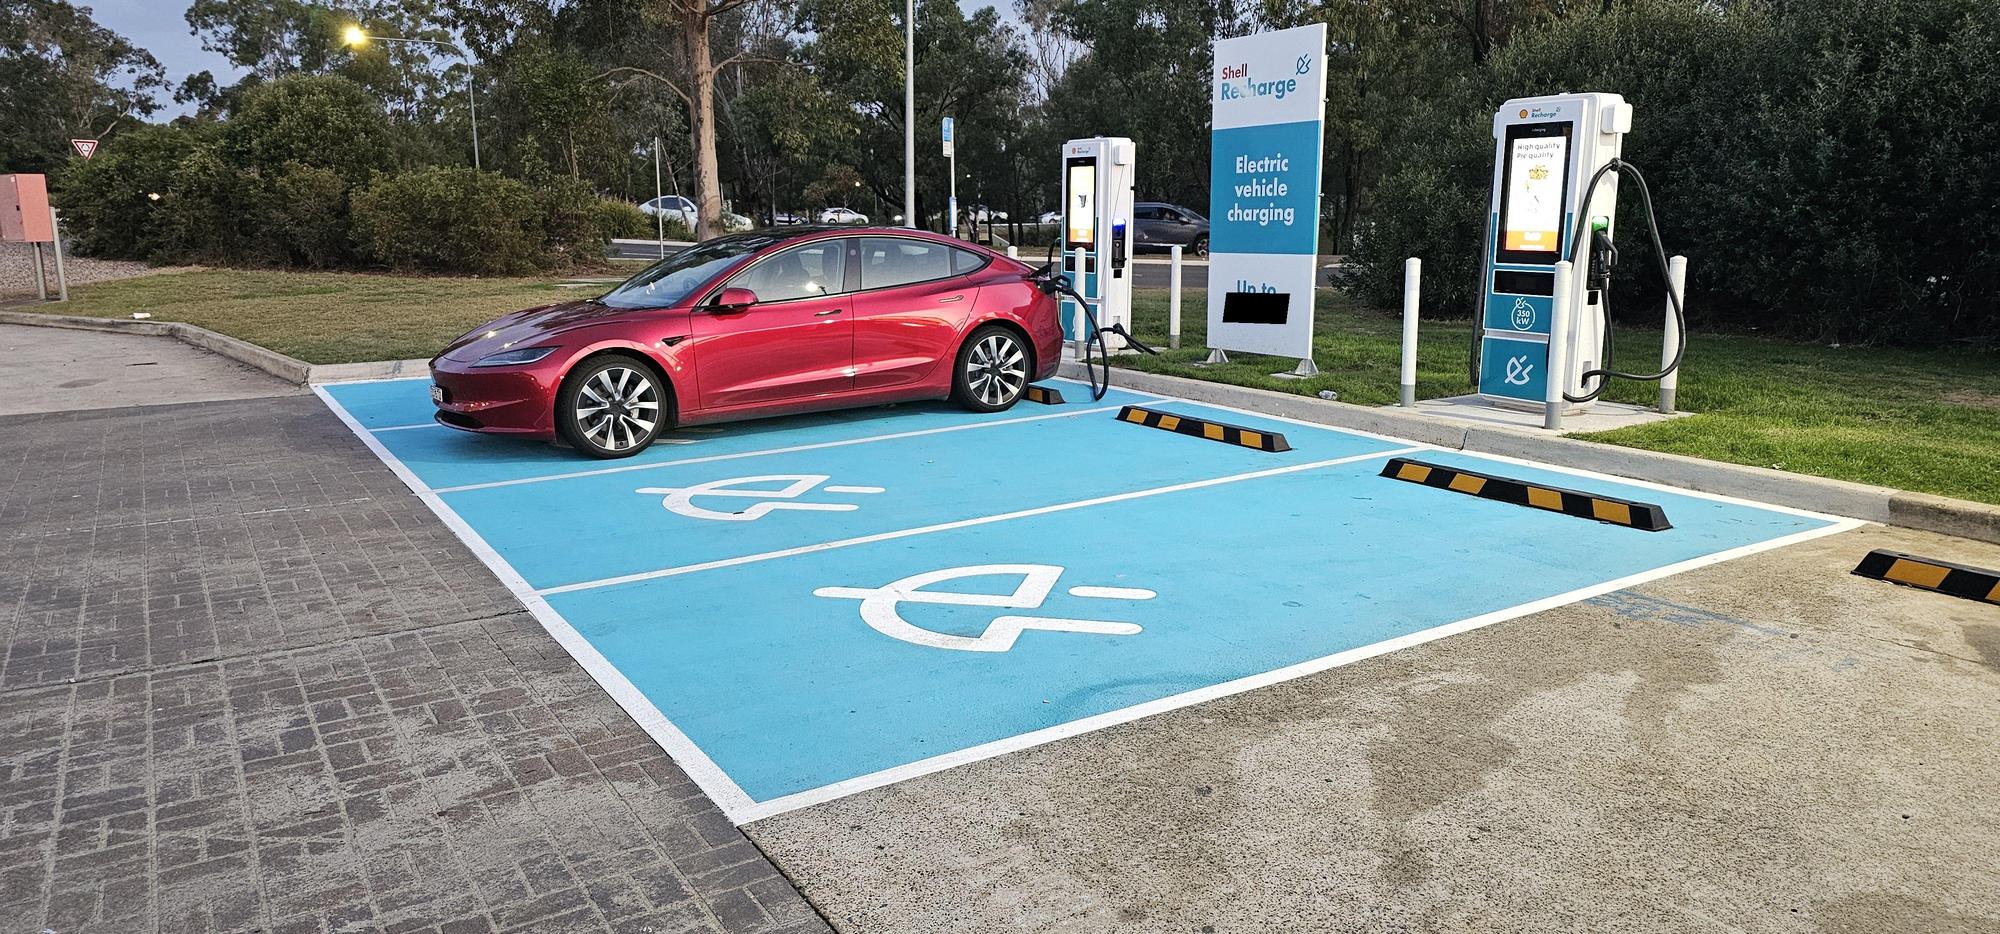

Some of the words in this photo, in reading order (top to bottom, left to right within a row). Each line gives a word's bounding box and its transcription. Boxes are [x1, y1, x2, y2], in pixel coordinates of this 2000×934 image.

[1222, 63, 1248, 80] Shell
[1221, 77, 1297, 100] Reharge
[1517, 143, 1534, 151] High
[1535, 143, 1561, 151] quality
[1236, 153, 1289, 174] Electric
[1234, 177, 1288, 197] vehicle
[1227, 202, 1295, 226] charging
[1516, 317, 1530, 325] kW
